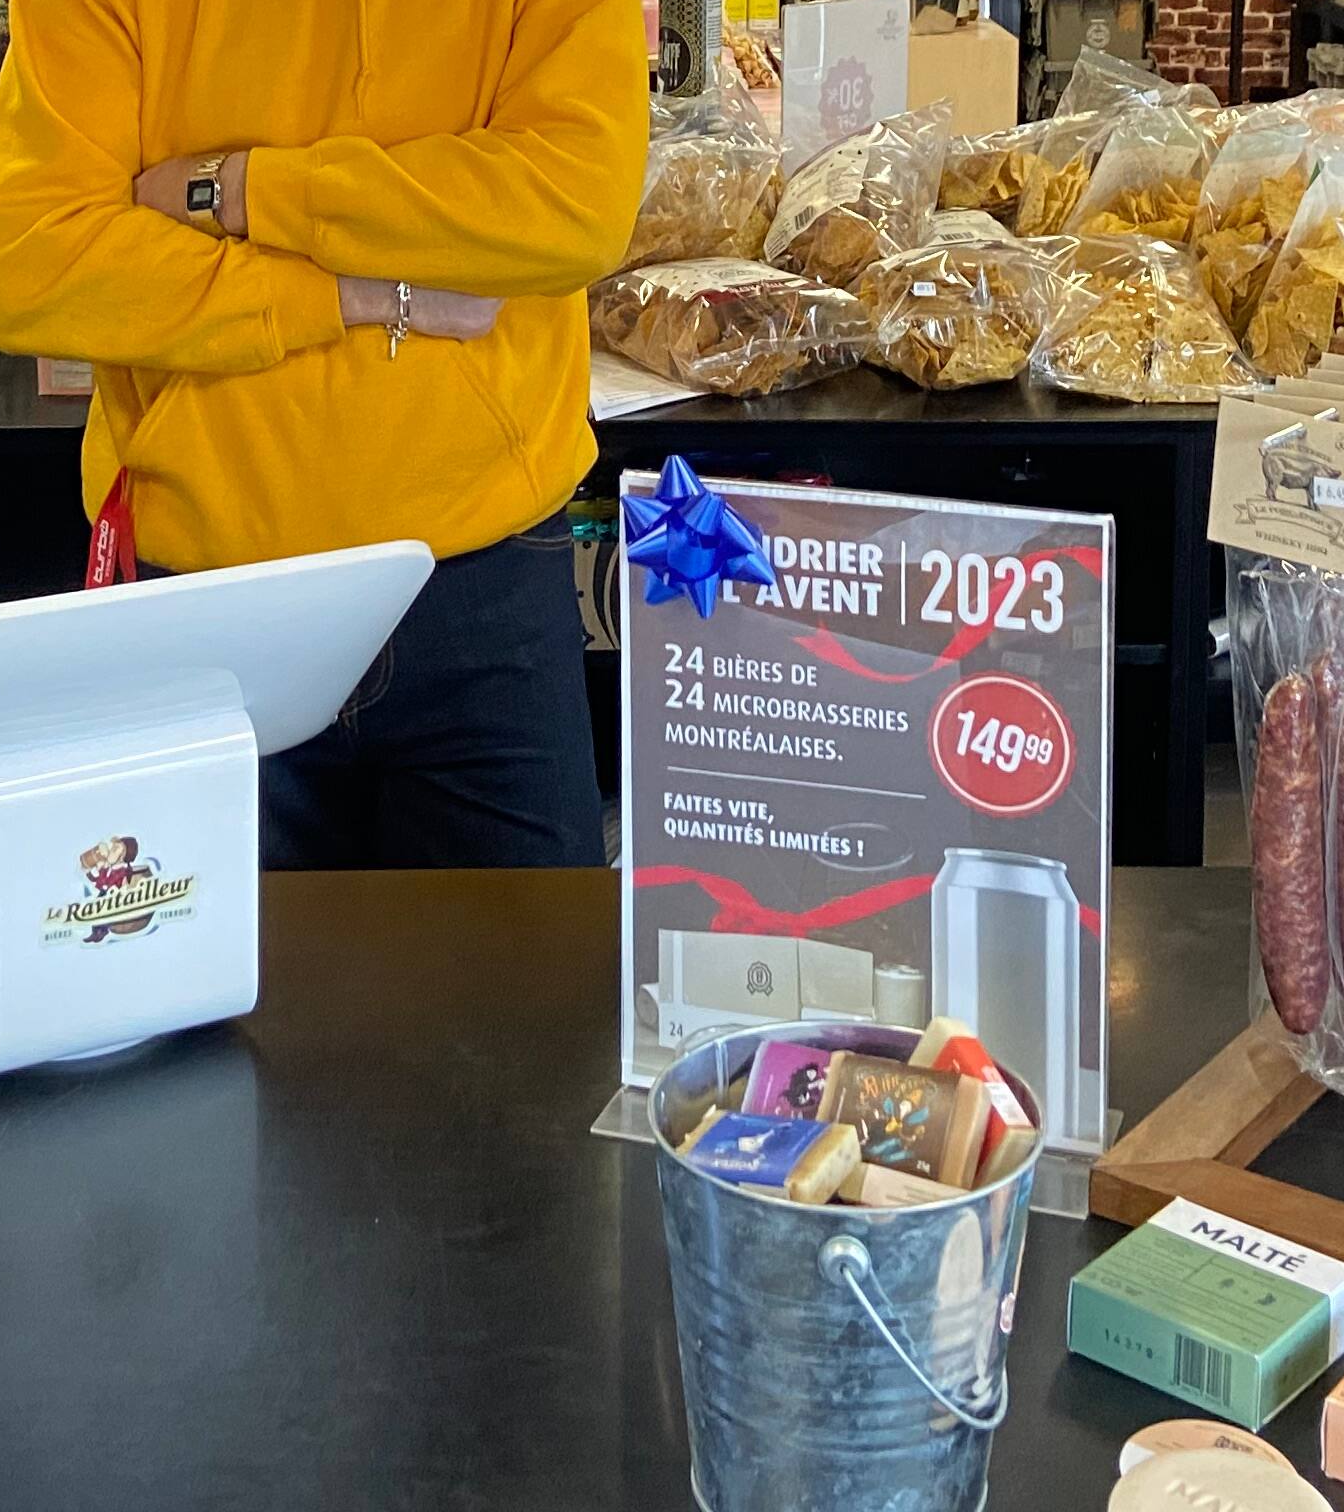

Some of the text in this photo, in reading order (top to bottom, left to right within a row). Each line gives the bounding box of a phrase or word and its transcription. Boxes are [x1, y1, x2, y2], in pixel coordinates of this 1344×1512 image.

[722, 574, 884, 617] LAVENT
[919, 549, 1065, 633] 2023
[664, 643, 819, 687] 24 BIÈRES DE
[664, 680, 910, 733] 24 MICROBRASSERIES
[663, 718, 845, 762] MONTRÉALAISES.
[663, 791, 774, 824] FAITES VITE,
[663, 813, 865, 857] QUANTITÉS LIMITÉES !
[47, 874, 195, 923] Le Ravitailleur
[669, 1020, 684, 1038] 24
[1191, 1220, 1308, 1274] MALTÉ
